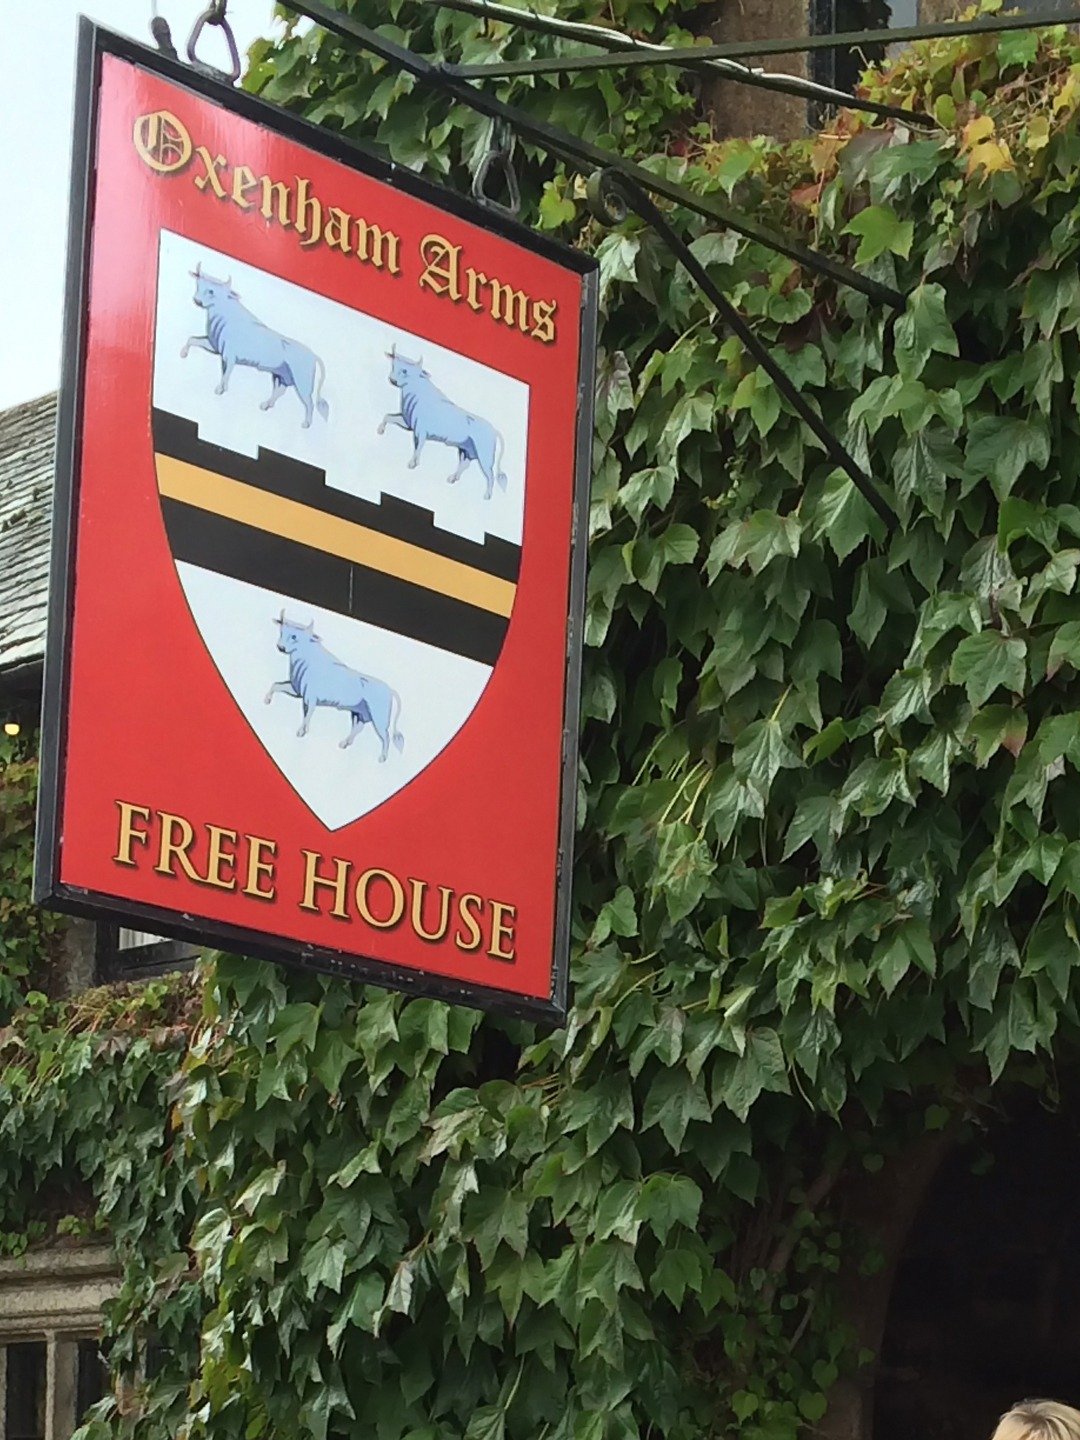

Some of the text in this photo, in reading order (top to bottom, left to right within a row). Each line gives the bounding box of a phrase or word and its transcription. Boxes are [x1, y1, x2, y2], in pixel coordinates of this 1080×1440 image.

[132, 110, 558, 343] Oxenham Arms
[113, 801, 518, 961] FREE HOUSE
